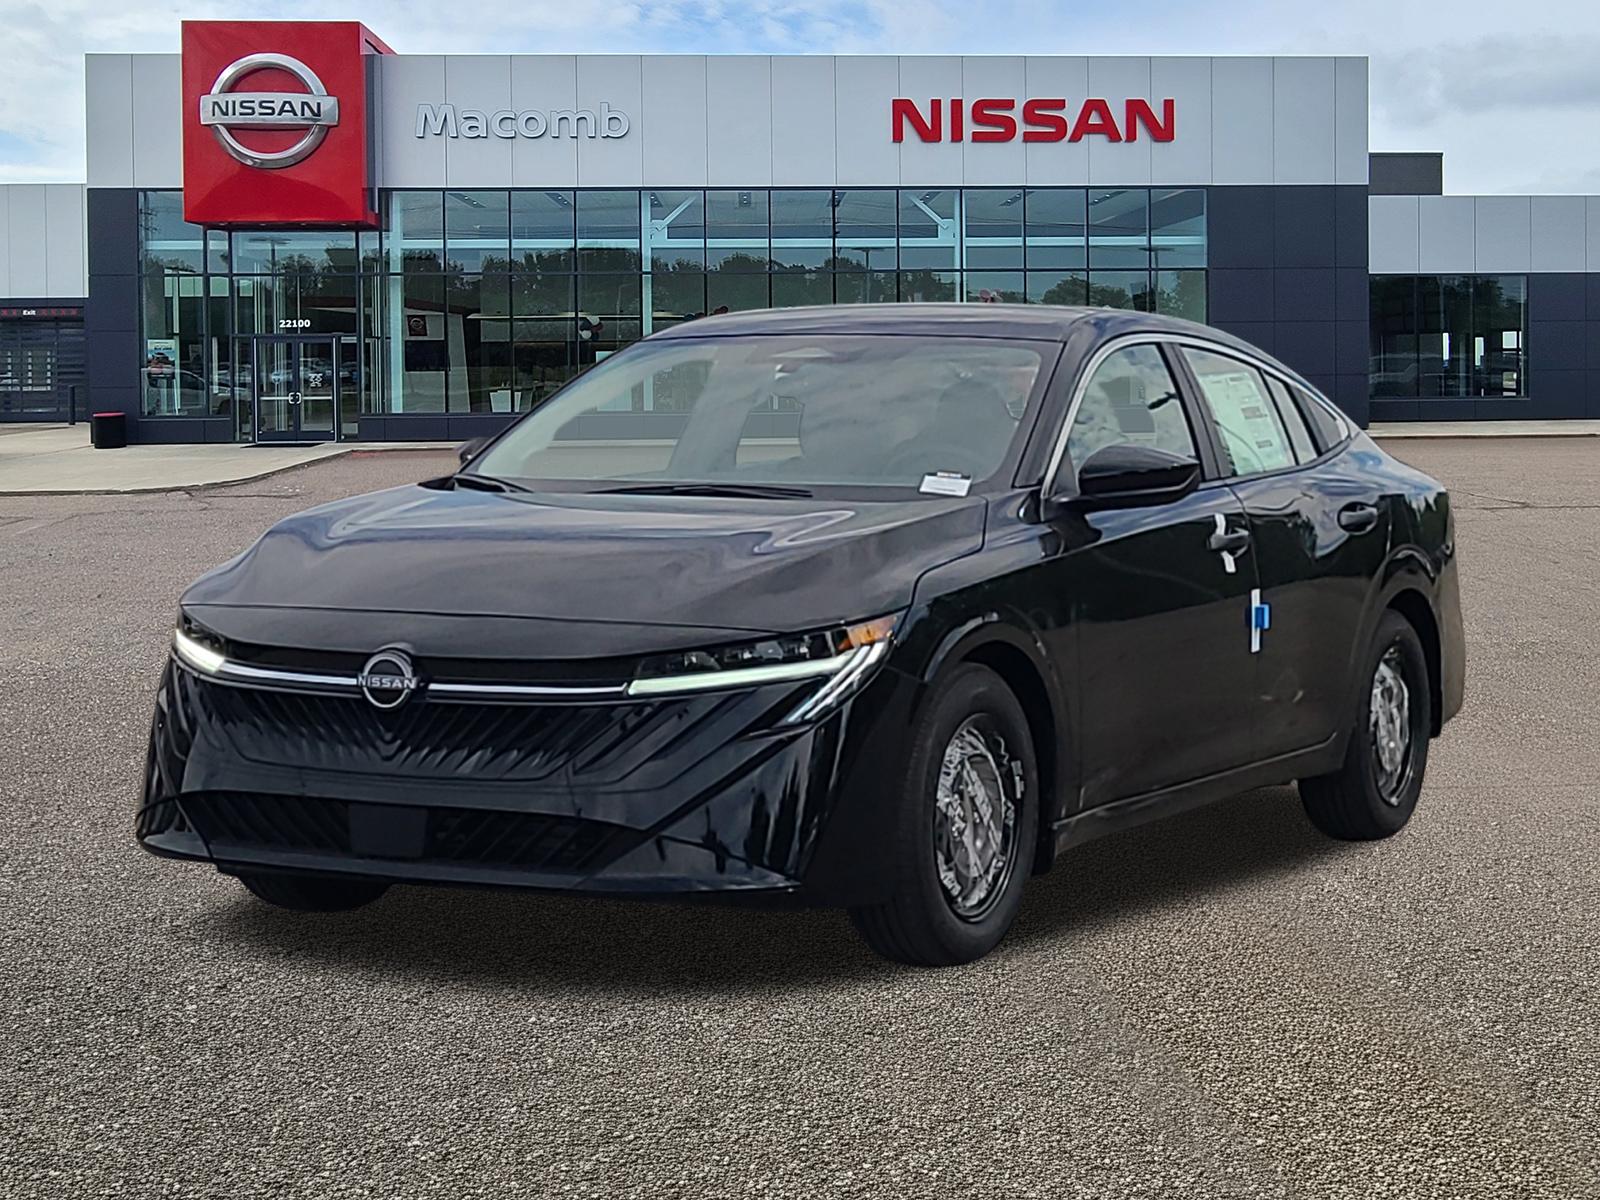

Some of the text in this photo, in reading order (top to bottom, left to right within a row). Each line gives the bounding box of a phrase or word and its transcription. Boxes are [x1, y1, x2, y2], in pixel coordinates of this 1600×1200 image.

[211, 100, 322, 118] NISSAN
[415, 102, 630, 139] Macomb
[892, 98, 1175, 143] NISSAN
[279, 319, 311, 328] 22100
[357, 674, 417, 689] NISSAN
